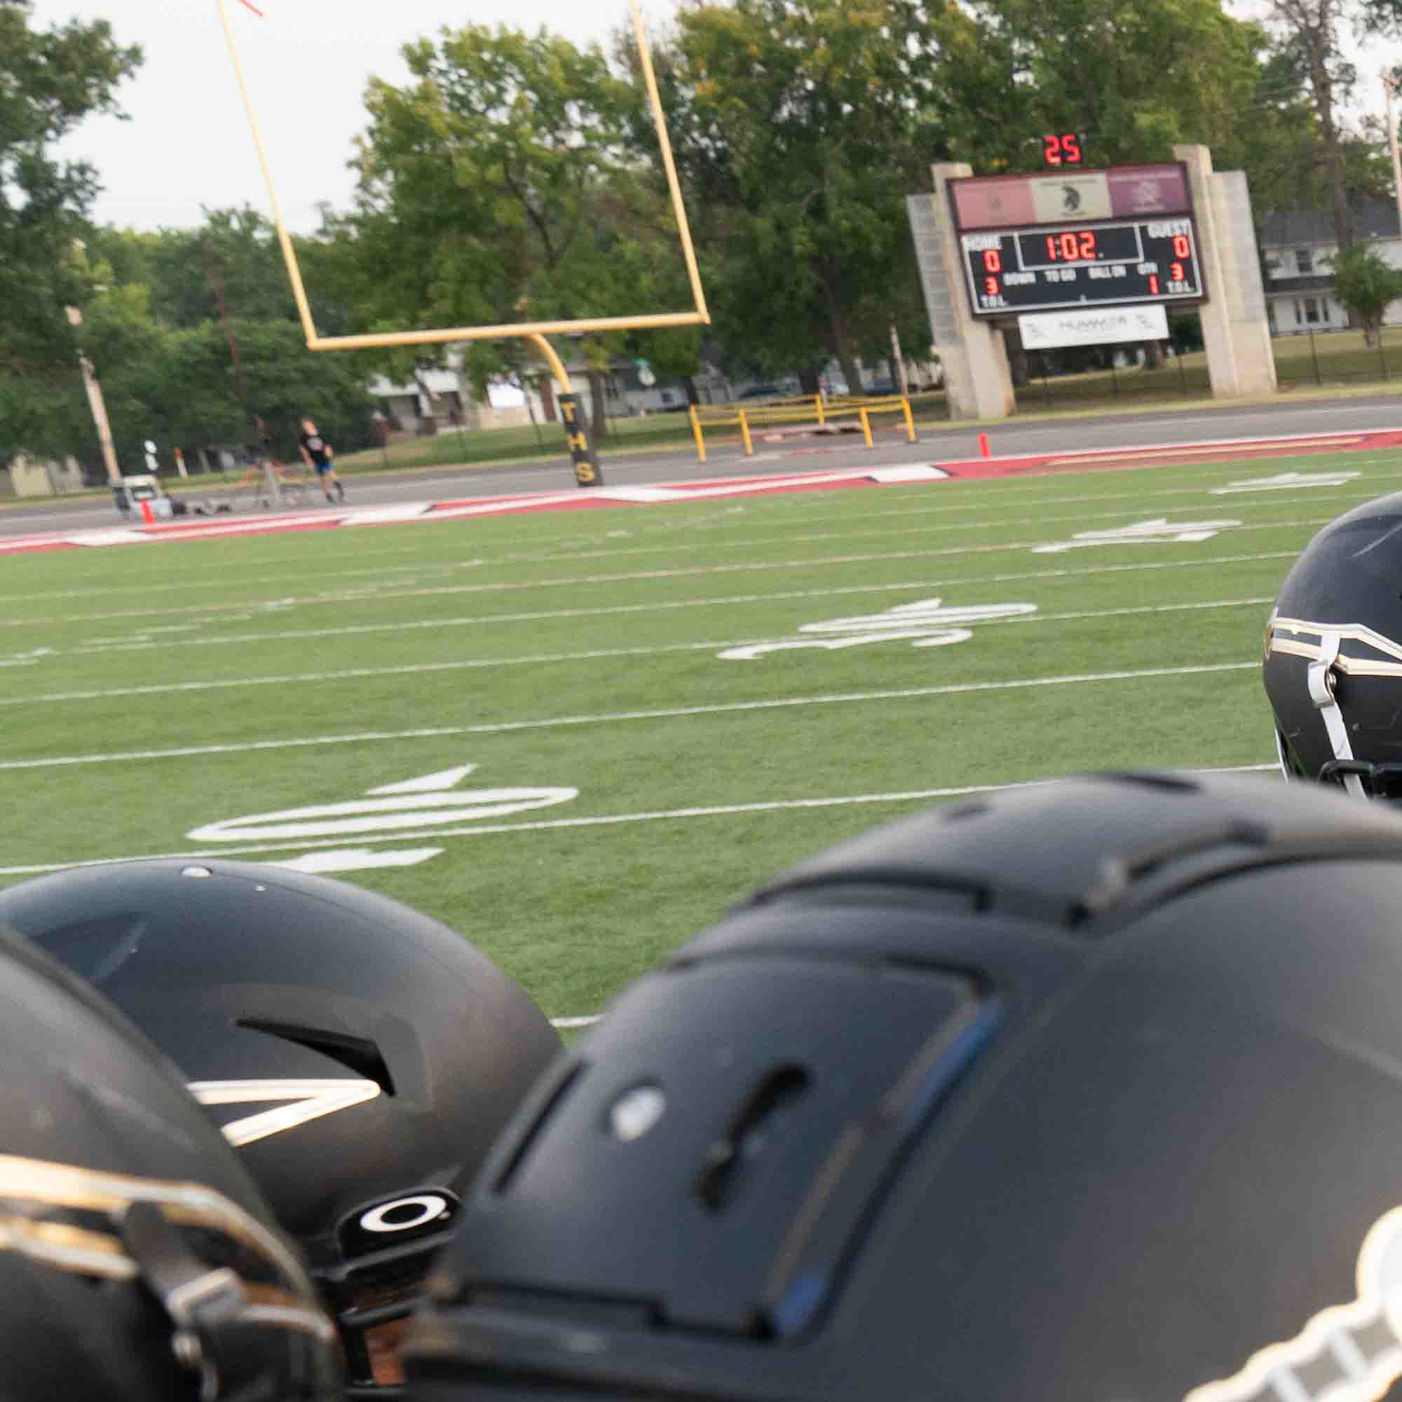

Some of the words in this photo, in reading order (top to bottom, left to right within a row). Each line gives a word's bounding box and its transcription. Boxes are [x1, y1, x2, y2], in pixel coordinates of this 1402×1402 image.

[1044, 134, 1081, 165] 25
[1173, 235, 1191, 259] 0
[983, 249, 1001, 272] 0
[1170, 261, 1184, 281] 3
[986, 276, 999, 296] 3
[1149, 273, 1159, 296] 1
